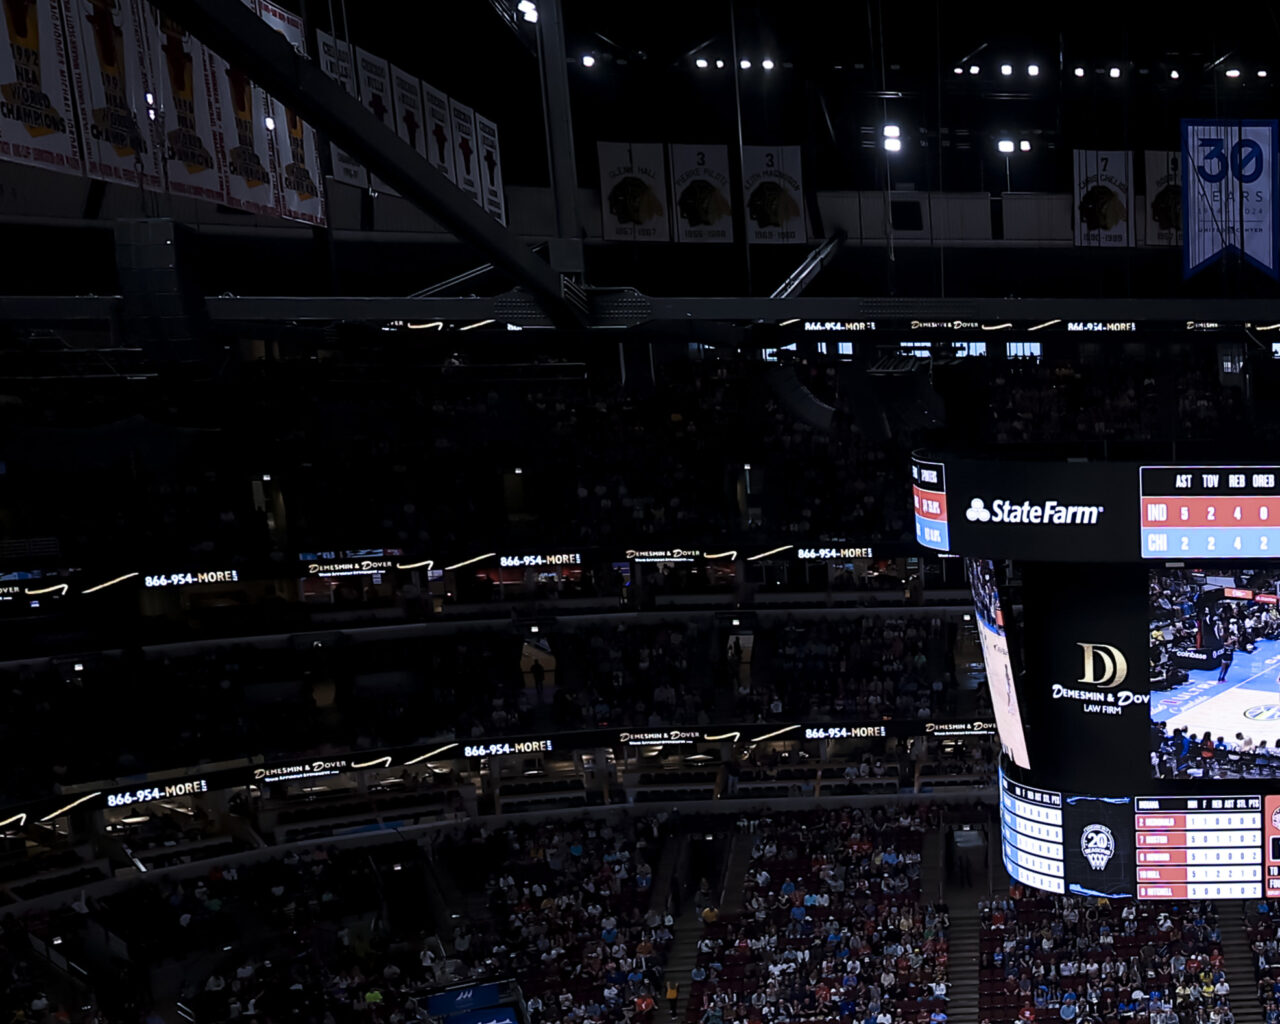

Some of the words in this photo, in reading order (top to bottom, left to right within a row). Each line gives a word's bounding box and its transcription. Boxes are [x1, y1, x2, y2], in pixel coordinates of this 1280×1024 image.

[1, 103, 67, 134] CHAMPIONS
[696, 152, 706, 166] 3
[765, 153, 774, 168] 3
[1101, 158, 1109, 172] 7
[1198, 138, 1263, 183] 30
[1198, 191, 1263, 202] YEARS
[1175, 474, 1192, 488] AST
[1202, 474, 1219, 488] TOV
[1229, 474, 1246, 488] REB
[1252, 474, 1275, 488] OREB
[1147, 503, 1167, 521] IND
[1207, 507, 1215, 520] 2
[1233, 507, 1242, 520] 4
[1148, 534, 1167, 551] CHI
[1181, 537, 1189, 550] 2
[1207, 537, 1215, 550] 2
[1233, 537, 1242, 550] 4
[1260, 537, 1268, 550] 2
[500, 554, 575, 568] 866-954-MORE
[797, 548, 868, 559] 866-954-MORE
[145, 570, 232, 587] 866-954-MORE
[1052, 683, 1105, 702] DEMESMIN
[1107, 693, 1115, 702] &
[1117, 690, 1150, 706] DOV
[1083, 703, 1101, 713] LAW
[1102, 705, 1122, 715] FIRM
[805, 727, 880, 739] 866-954-MORE
[464, 740, 546, 757] 866-954-MORE
[312, 760, 347, 773] DOVER
[107, 781, 201, 807] 866-954-MORE
[1087, 833, 1108, 848] 20
